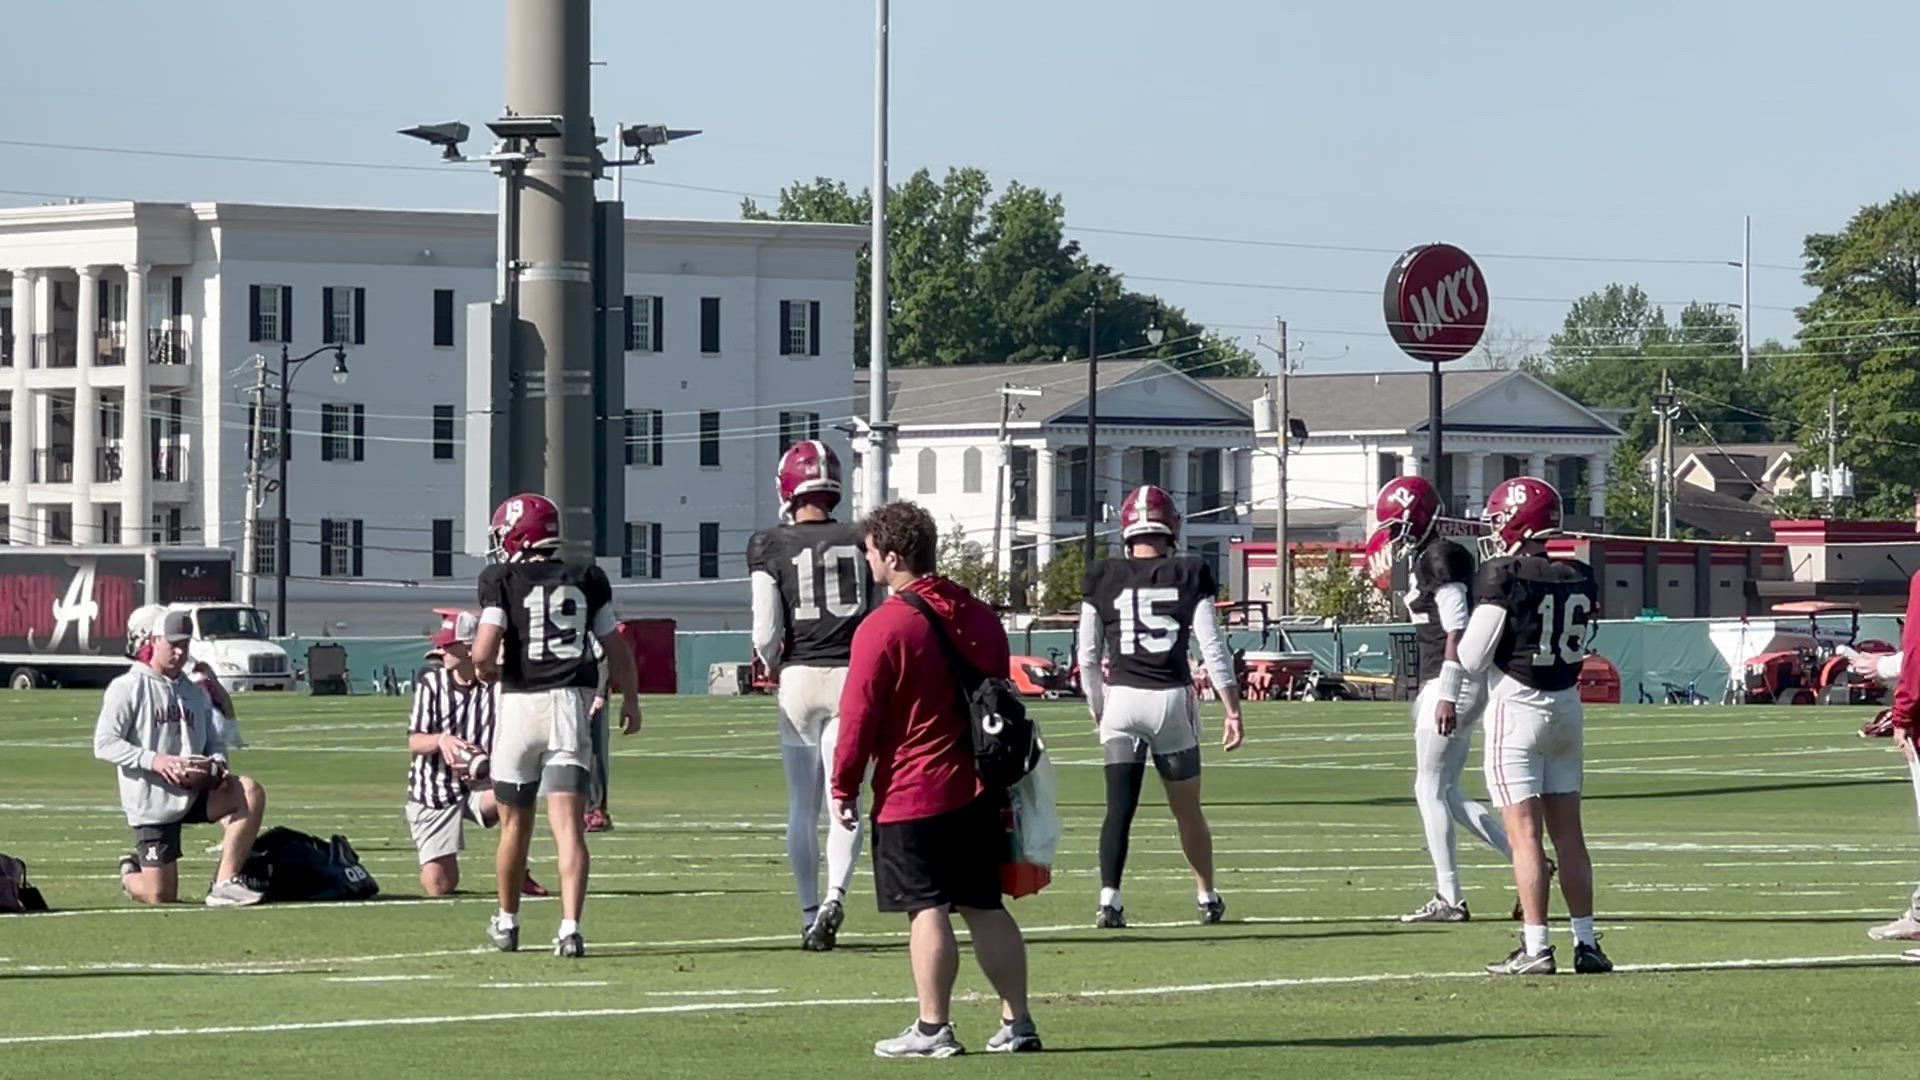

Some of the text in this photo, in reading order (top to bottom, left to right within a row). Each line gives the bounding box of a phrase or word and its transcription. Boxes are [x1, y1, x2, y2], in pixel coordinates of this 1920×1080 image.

[1409, 265, 1479, 341] JACK'S
[506, 500, 523, 524] 19
[1387, 487, 1415, 508] 12
[1505, 485, 1528, 506] 16
[791, 545, 867, 620] 10
[523, 585, 587, 660] 19
[1113, 588, 1180, 654] 15
[1532, 594, 1591, 666] 16
